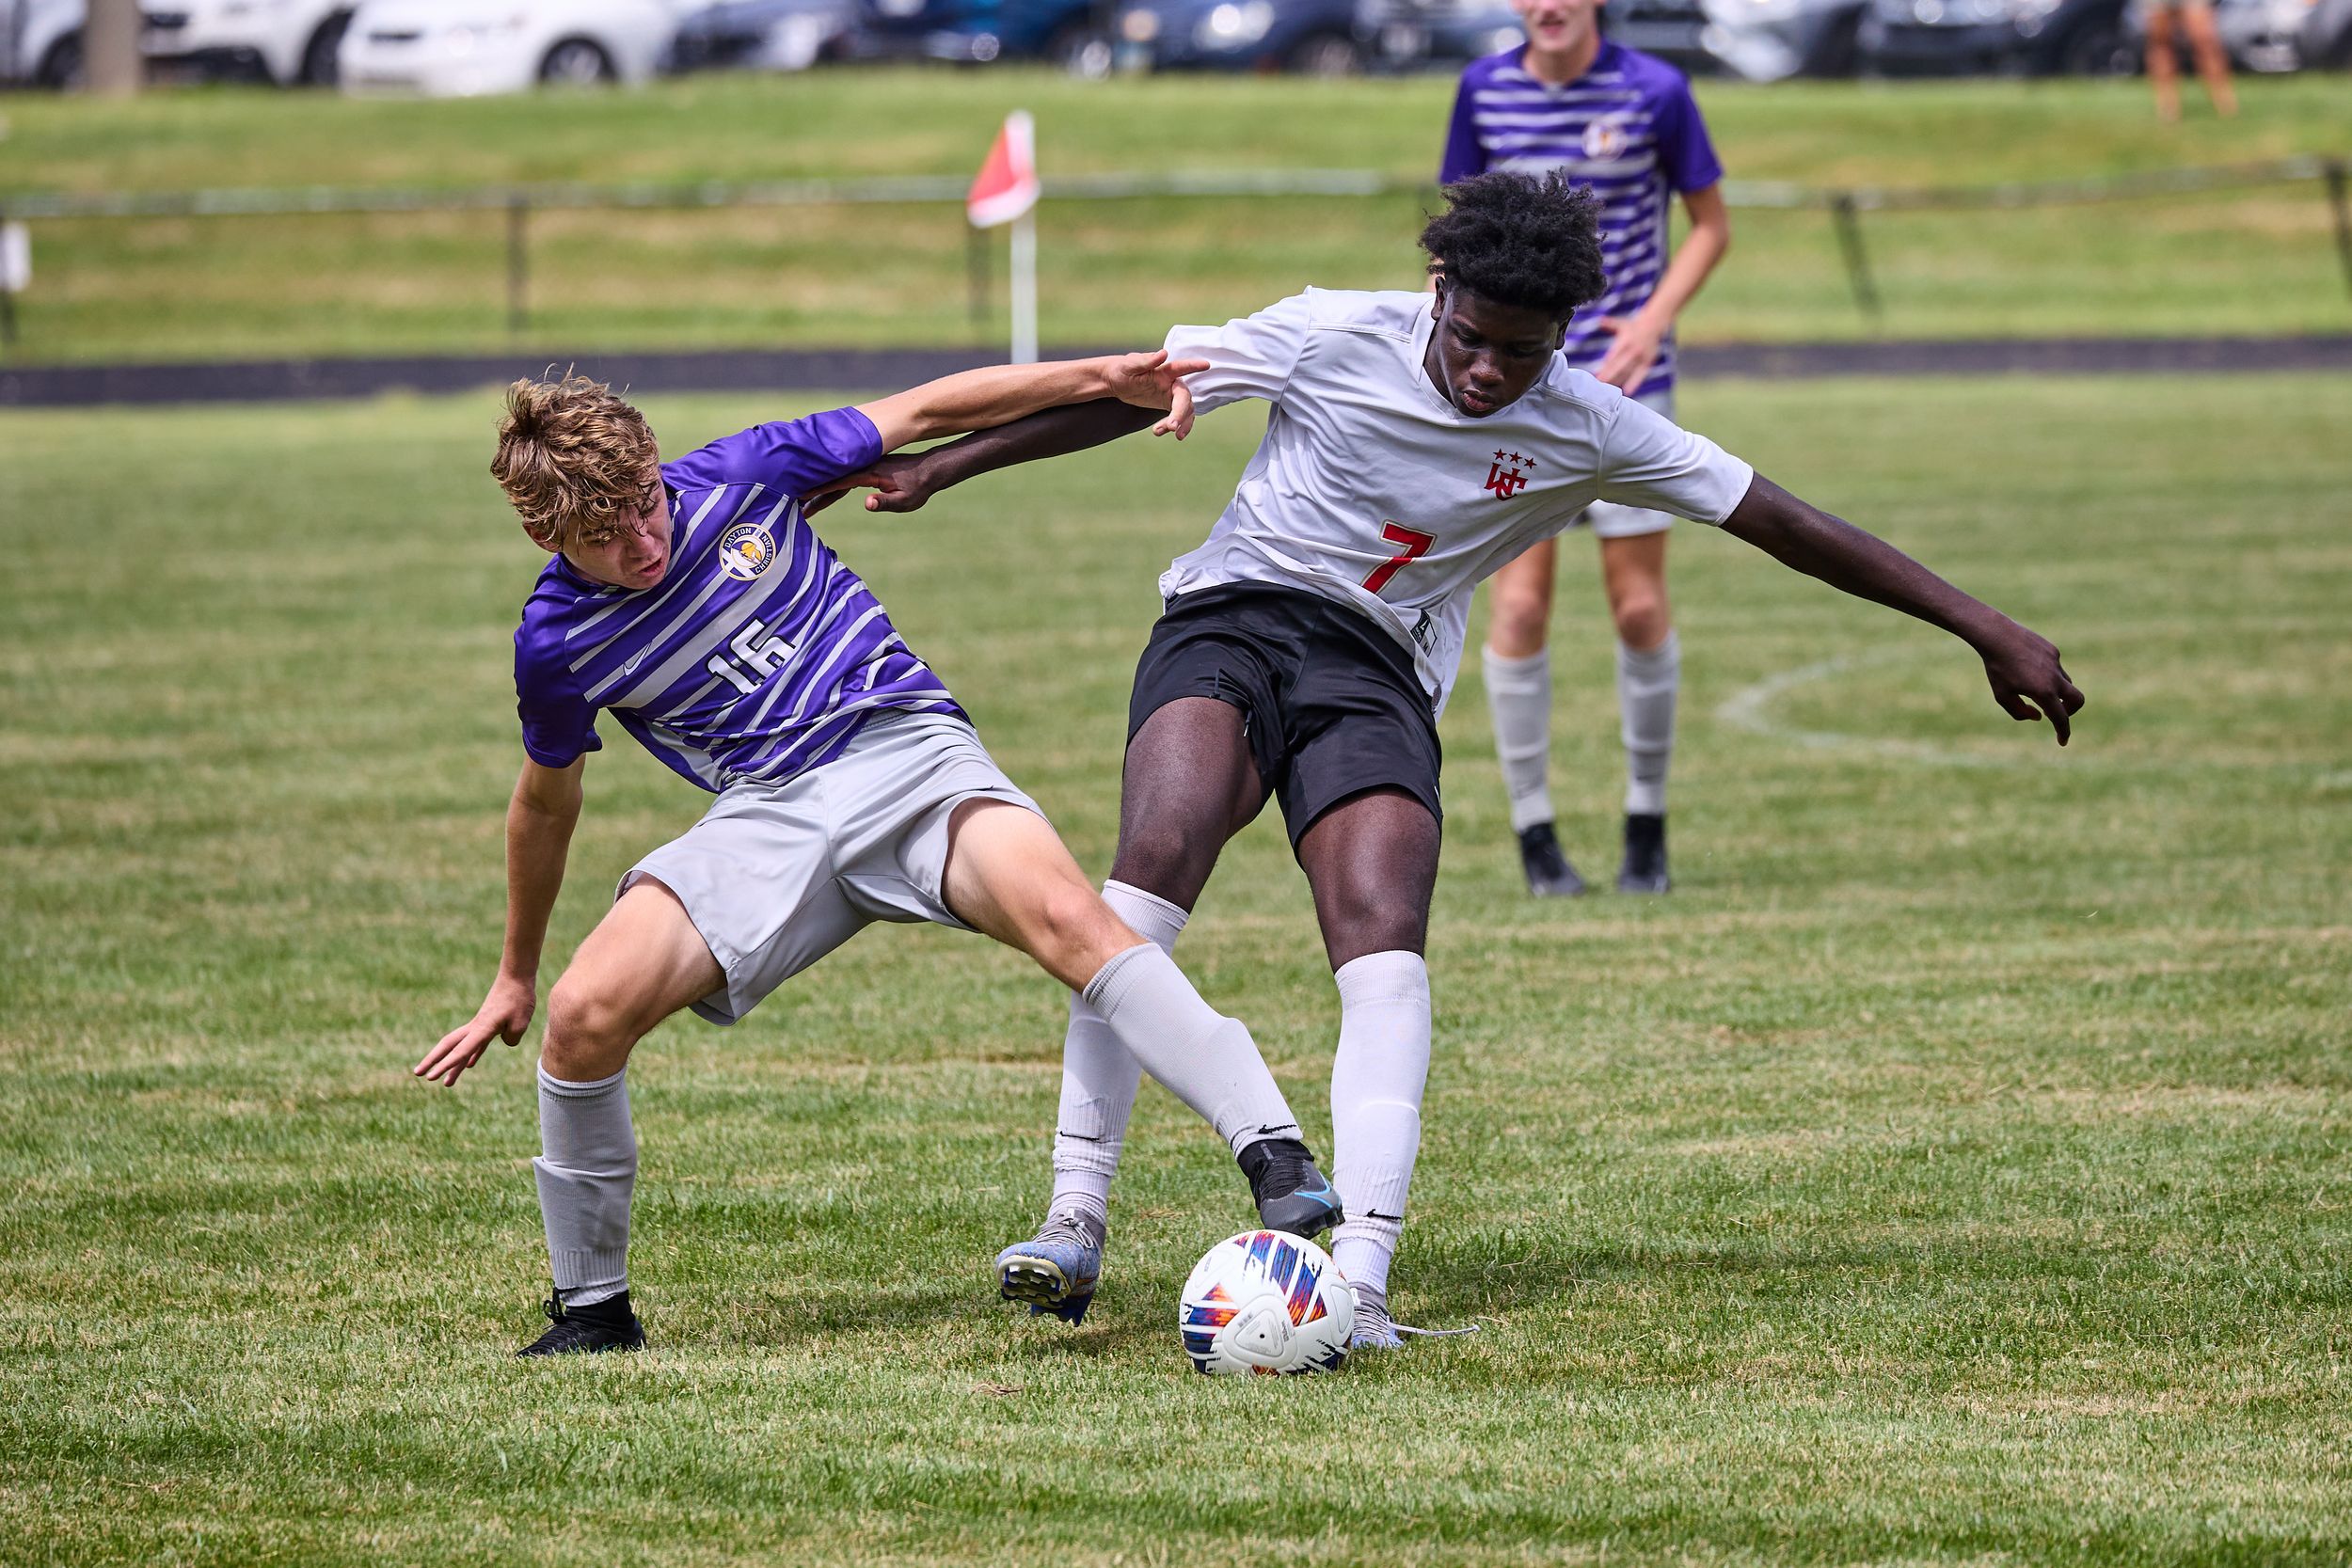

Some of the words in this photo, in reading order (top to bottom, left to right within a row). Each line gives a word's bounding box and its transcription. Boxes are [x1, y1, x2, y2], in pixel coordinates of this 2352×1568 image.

[724, 527, 753, 548] DAYTON
[755, 535, 773, 574] CHRISTIAN
[1360, 519, 1438, 594] 7
[707, 617, 797, 695] 16
